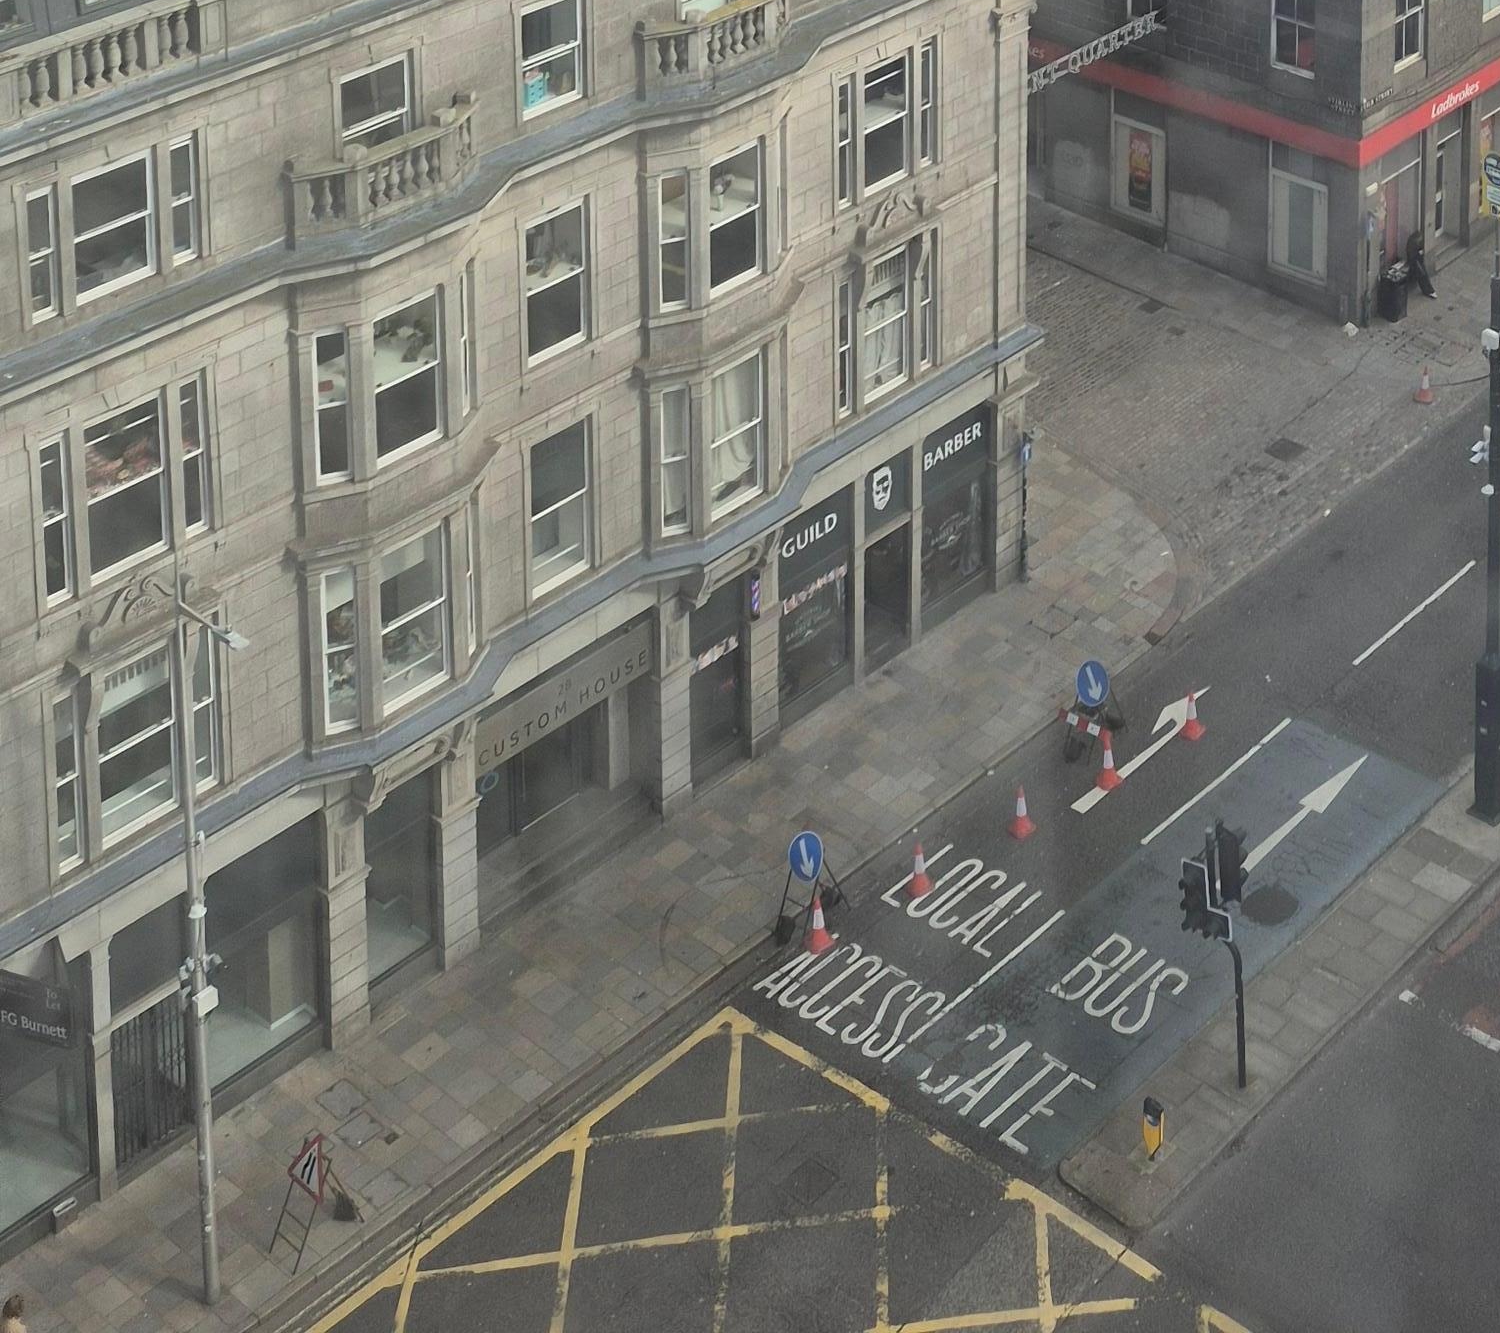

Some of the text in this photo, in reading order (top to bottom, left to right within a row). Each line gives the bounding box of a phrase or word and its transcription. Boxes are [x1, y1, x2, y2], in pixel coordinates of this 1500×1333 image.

[1068, 11, 1158, 74] QUARTER
[1431, 80, 1480, 119] Ladbrokes
[923, 421, 983, 472] BARBER
[781, 512, 838, 559] GUILD
[478, 648, 648, 767] CUSTOM HOUSE
[880, 843, 1042, 958] LOCAL
[752, 933, 947, 1061] ACCESS
[1045, 933, 1189, 1034] BUS
[21, 1015, 67, 1039] Burnett
[917, 1023, 1097, 1154] GATE
